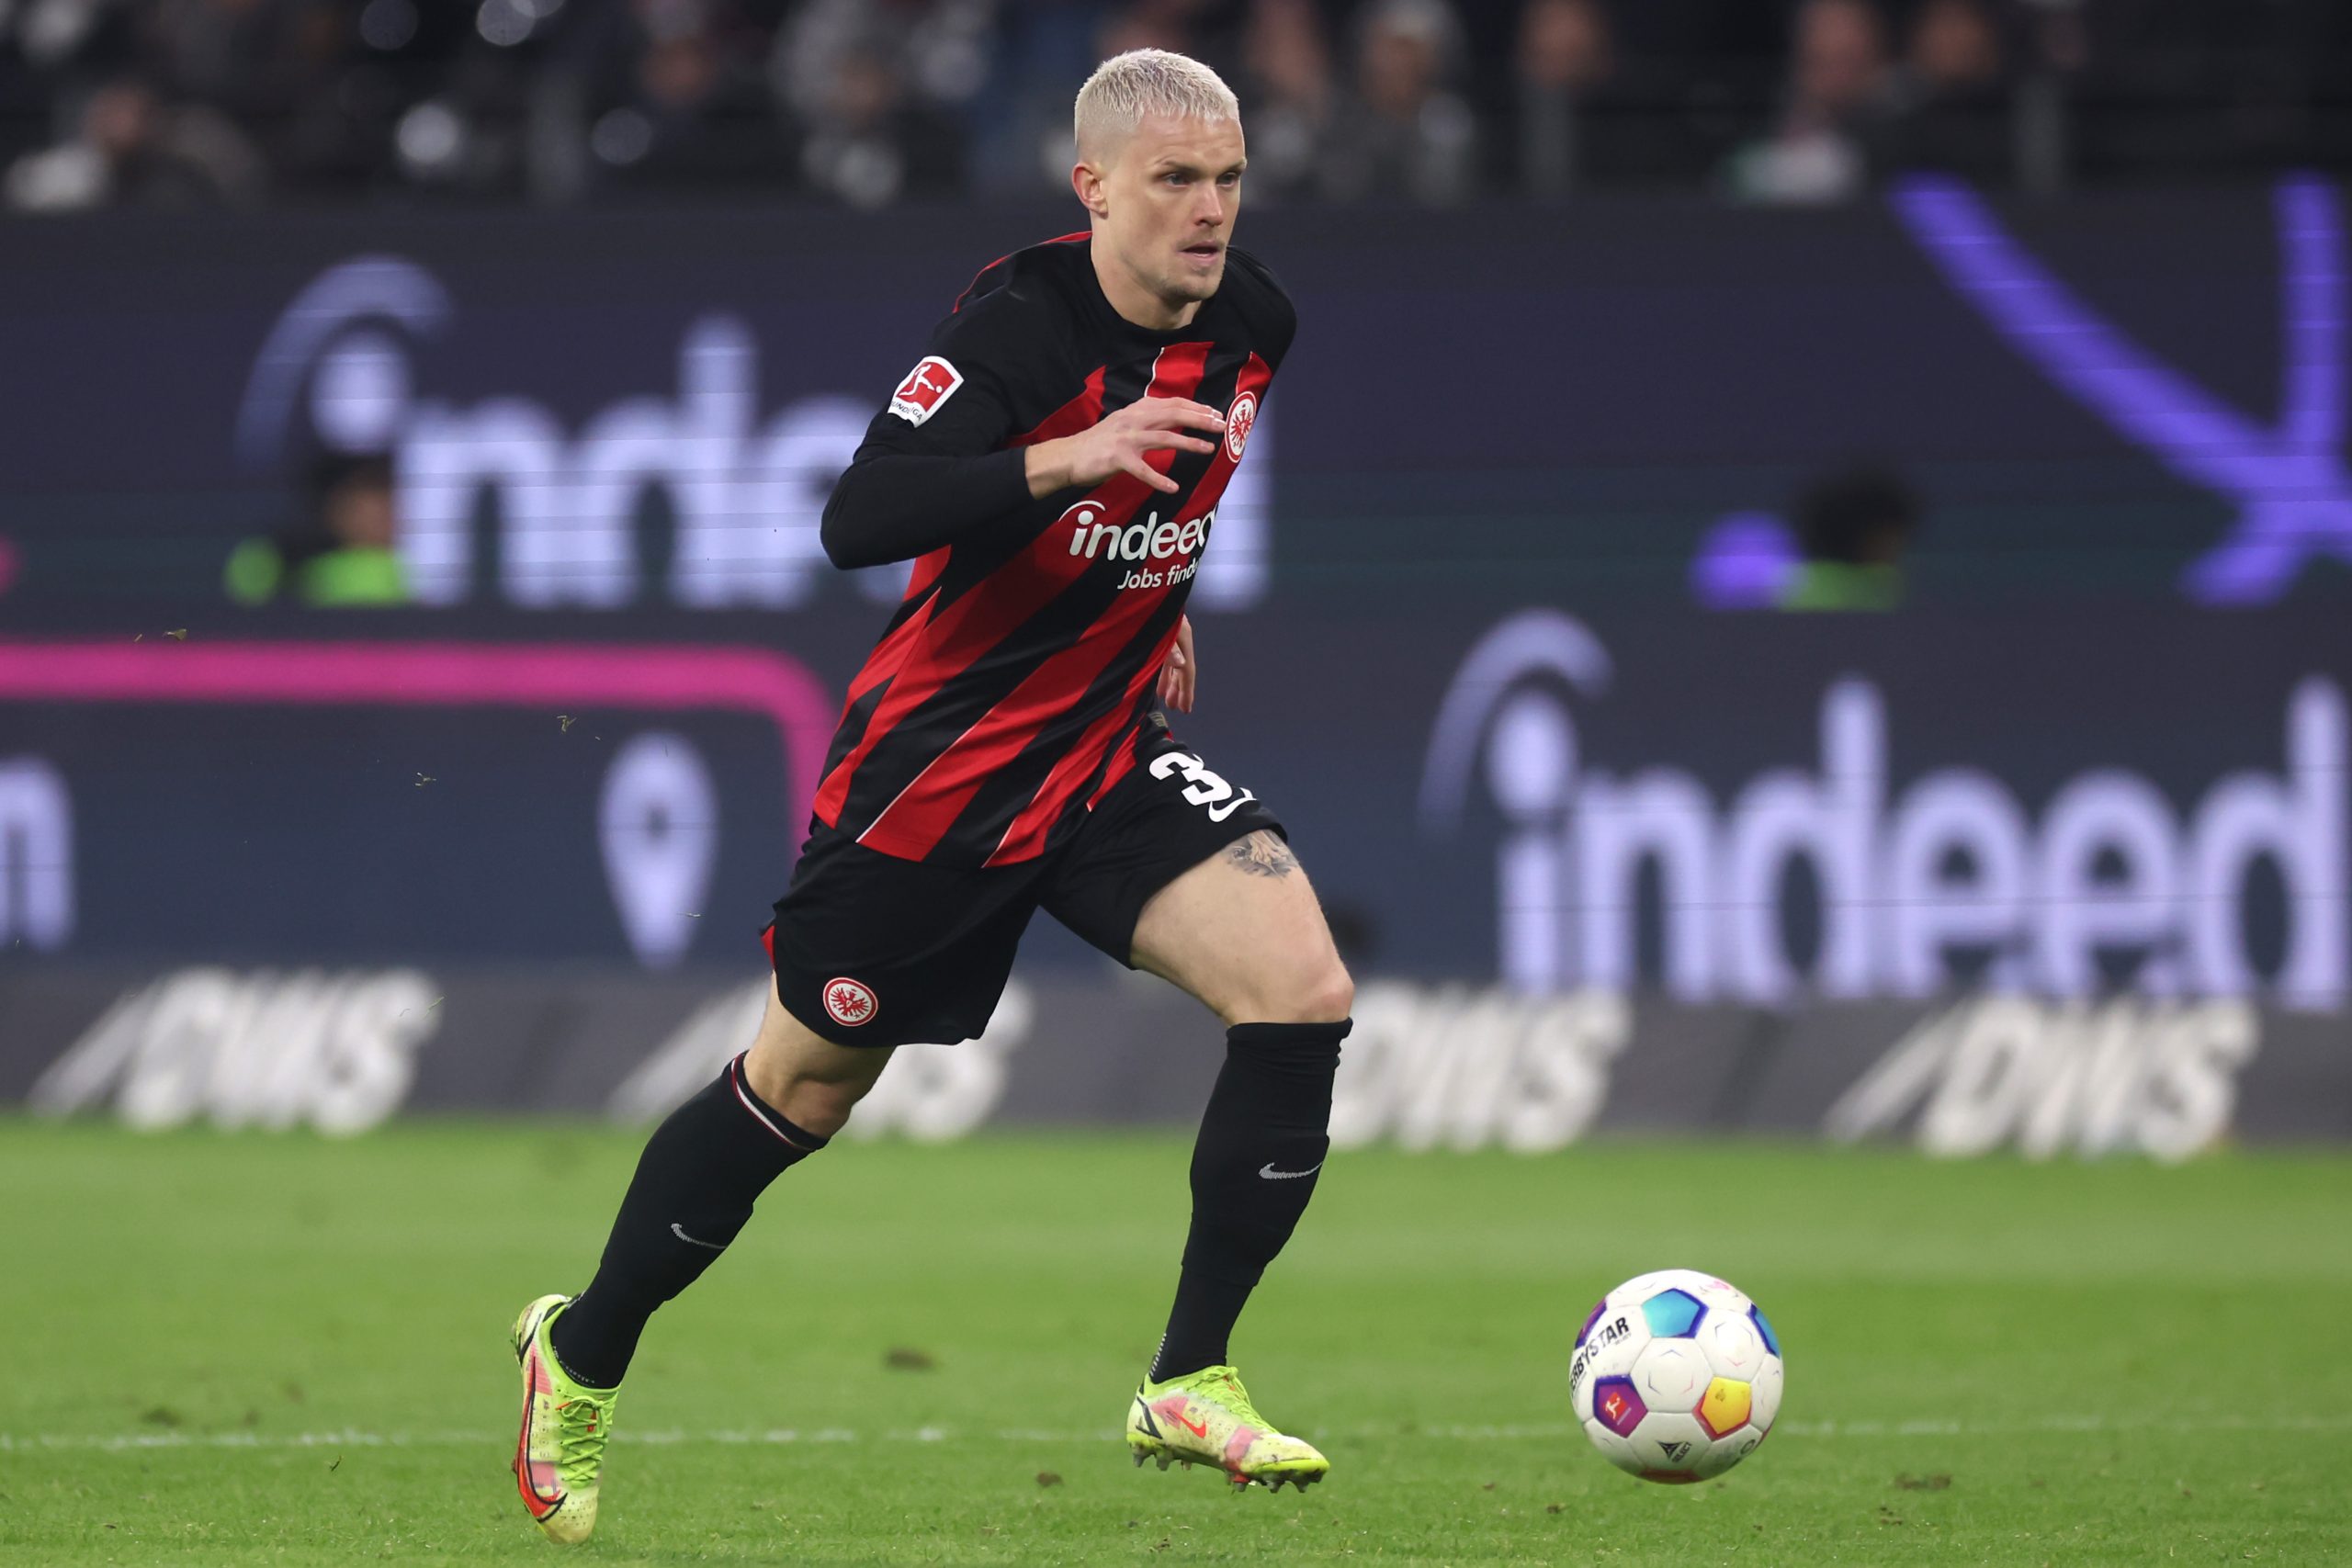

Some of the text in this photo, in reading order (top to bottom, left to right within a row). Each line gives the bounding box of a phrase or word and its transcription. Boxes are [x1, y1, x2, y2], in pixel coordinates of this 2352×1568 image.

[1117, 568, 1162, 590] Jobs
[1149, 751, 1253, 807] 3
[1417, 608, 2350, 1013] indeed
